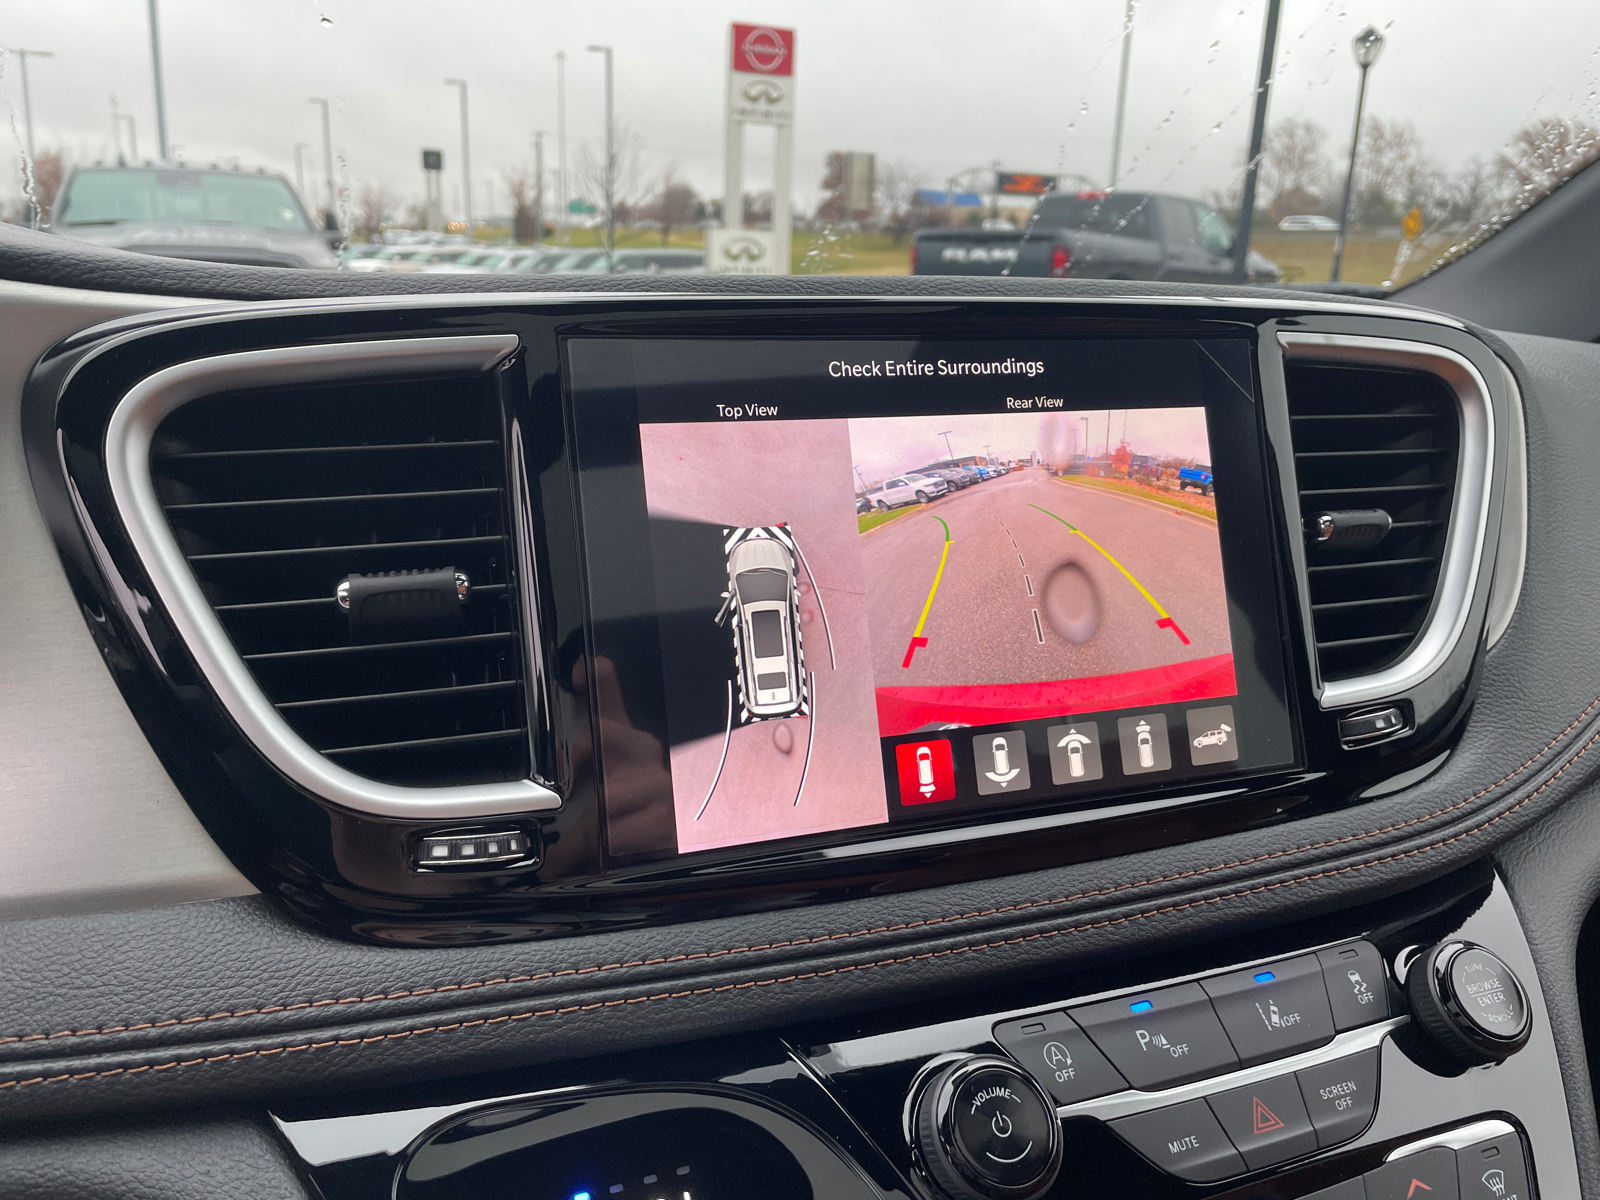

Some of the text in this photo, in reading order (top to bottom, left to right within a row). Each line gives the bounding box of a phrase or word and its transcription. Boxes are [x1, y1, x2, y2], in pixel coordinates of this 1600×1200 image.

[941, 247, 1018, 263] RAM
[828, 358, 1044, 377] Check Entire Surroundings
[1006, 396, 1064, 409] Rear View
[717, 403, 778, 419] Top View
[1465, 962, 1484, 974] TUNE
[1466, 978, 1502, 994] BROWSE
[1358, 992, 1374, 1004] OFF
[1477, 992, 1506, 1007] ENTER
[1284, 1013, 1301, 1026] OFF
[1488, 1009, 1514, 1023] SCROLL
[1135, 1029, 1189, 1057] P OFF
[1051, 1046, 1065, 1064] A
[1055, 1068, 1076, 1082] OFF
[972, 1086, 1011, 1106] VOLUME
[1319, 1080, 1357, 1100] SCREEN
[1335, 1097, 1353, 1111] OFF
[1168, 1135, 1200, 1154] MUTE
